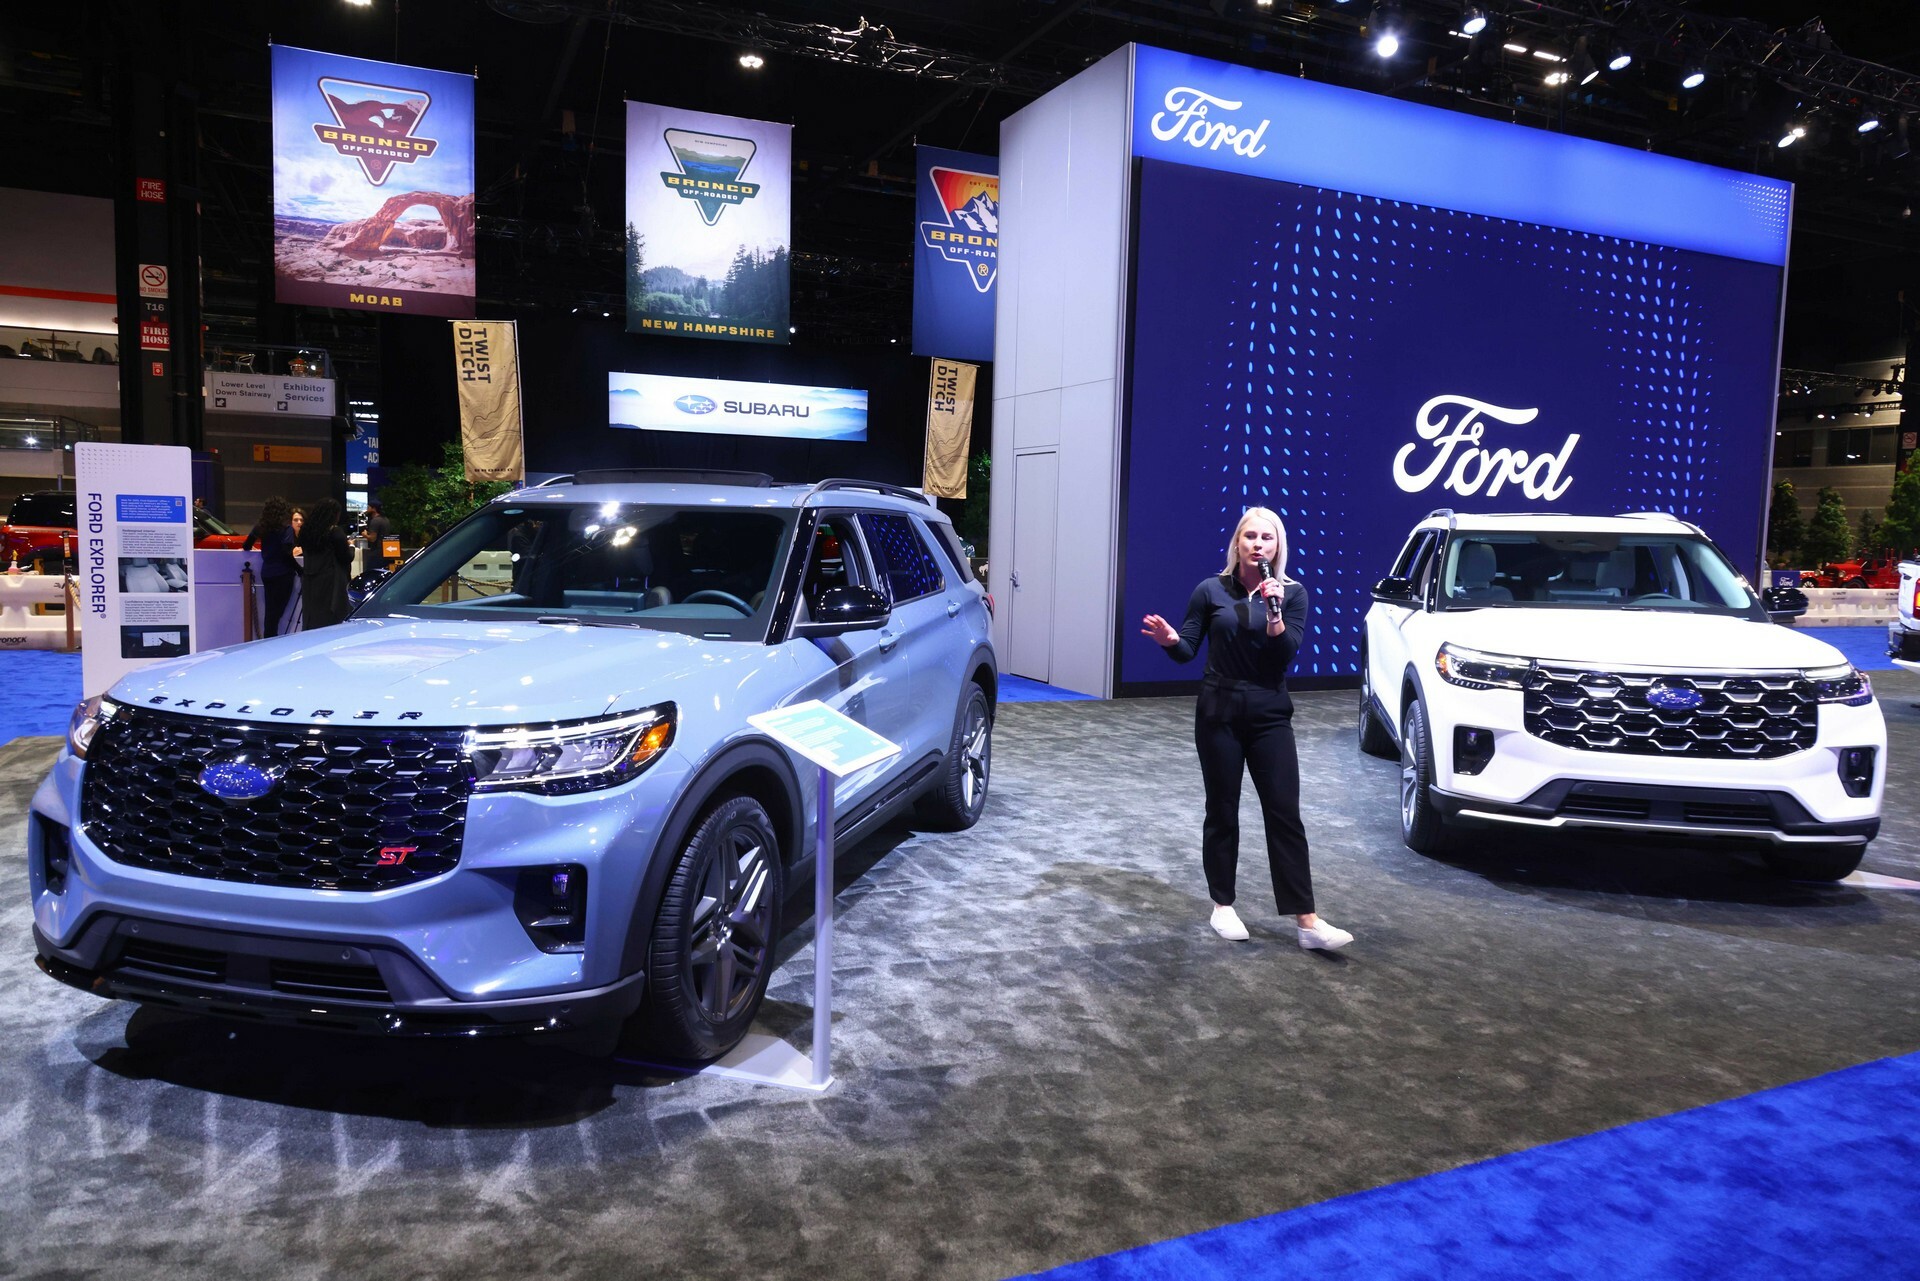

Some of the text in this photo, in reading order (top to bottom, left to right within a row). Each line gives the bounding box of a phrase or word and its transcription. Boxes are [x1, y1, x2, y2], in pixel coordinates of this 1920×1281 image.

[1151, 86, 1271, 158] Ford
[323, 130, 428, 152] BRONCO
[342, 144, 410, 158] OFF-ROADEO
[142, 181, 161, 190] FIRE
[667, 176, 753, 194] BRONCO
[141, 190, 164, 200] HOSE
[683, 188, 738, 200] OFF-ROADEO
[350, 293, 403, 307] MOAB
[145, 303, 165, 312] T16
[143, 326, 168, 336] FIRE
[642, 318, 775, 339] NEW HAMPSHIRE
[142, 335, 170, 345] HOSE
[458, 327, 476, 382] DITCH
[474, 327, 491, 384] TWIST
[221, 380, 243, 388] Lower
[283, 382, 326, 393] Exhibitor
[934, 365, 948, 412] DITCH
[945, 367, 958, 415] TWIST
[215, 388, 272, 399] Down Stairway
[284, 393, 325, 403] Services
[723, 400, 810, 418] SUBARU
[1393, 394, 1581, 501] Ford
[367, 452, 379, 463] AC
[88, 493, 103, 534] FORD
[1779, 576, 1794, 587] Ford
[148, 695, 424, 720] EXPLORER
[376, 847, 417, 866] ST
